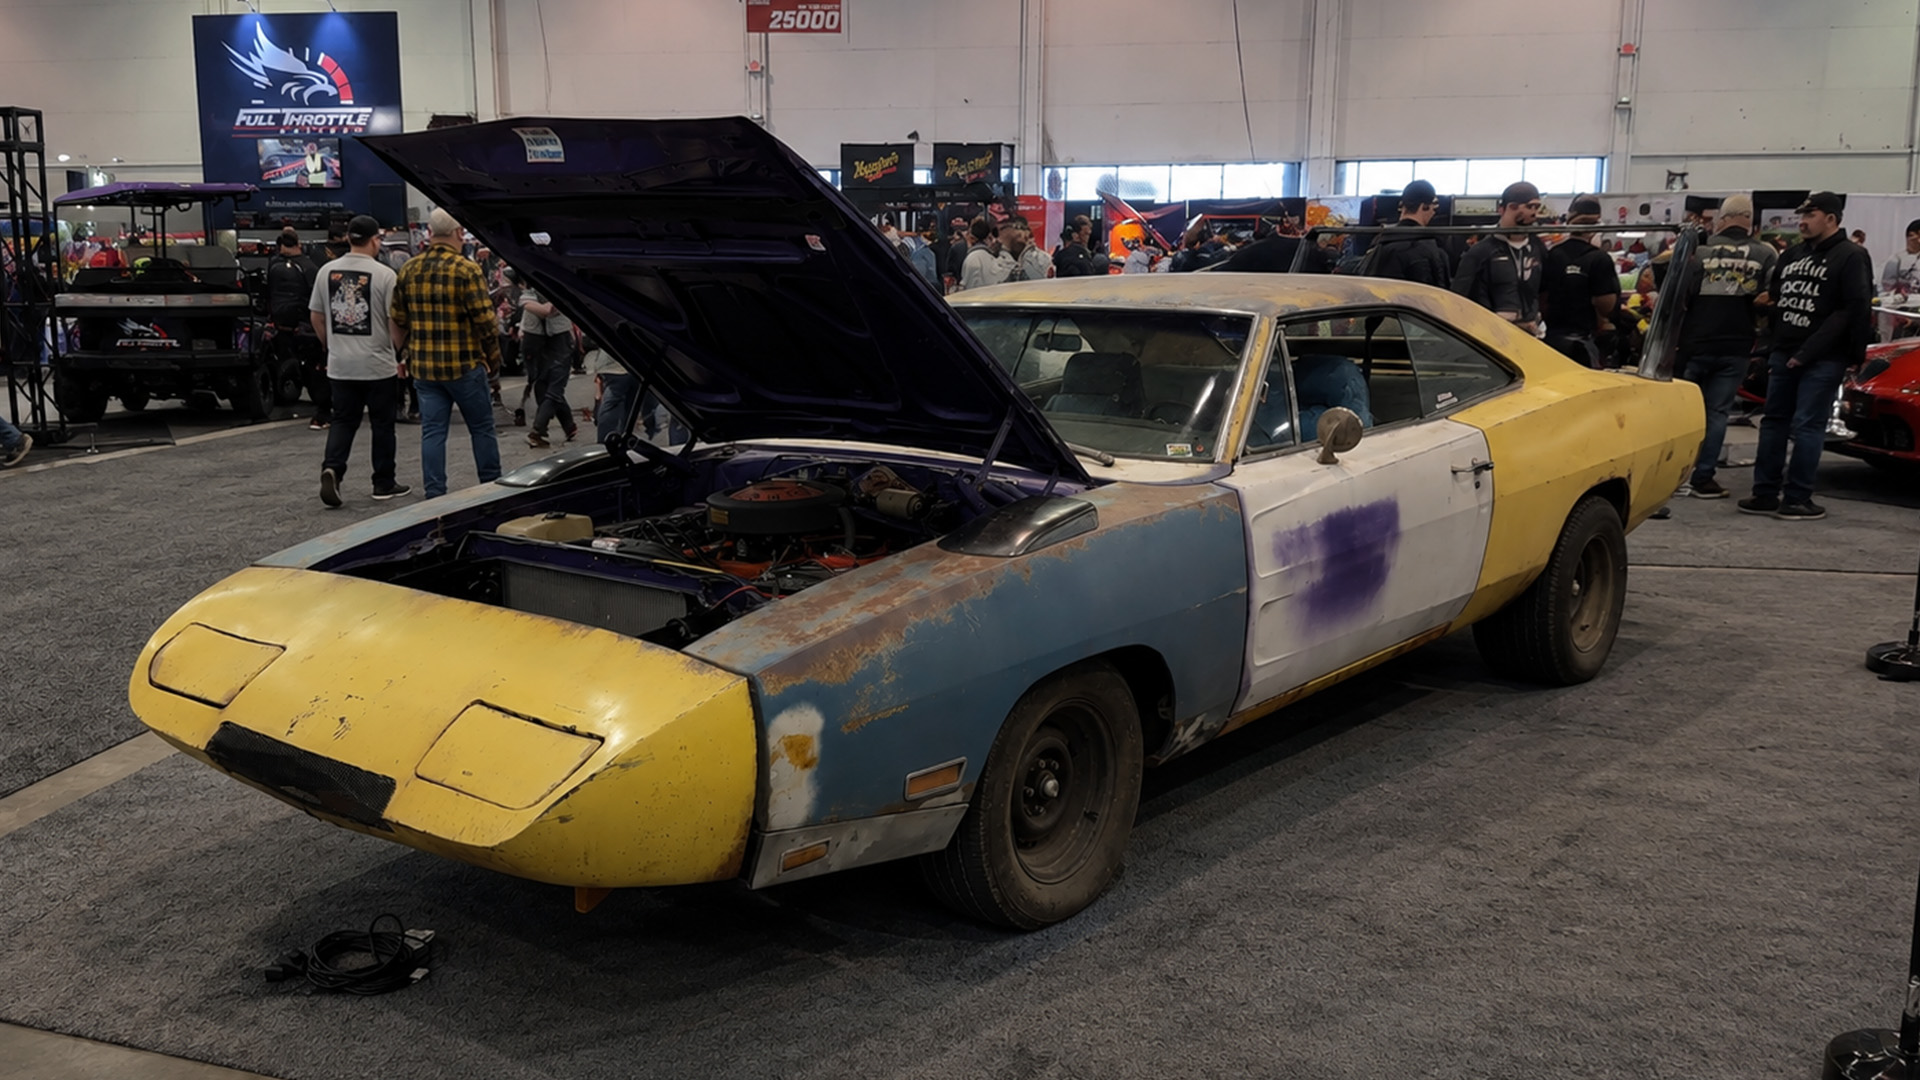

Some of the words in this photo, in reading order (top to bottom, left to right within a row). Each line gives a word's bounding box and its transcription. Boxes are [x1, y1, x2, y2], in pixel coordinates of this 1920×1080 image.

[769, 10, 840, 29] 25000
[235, 108, 281, 126] FULL
[281, 107, 373, 126] THROTTLE
